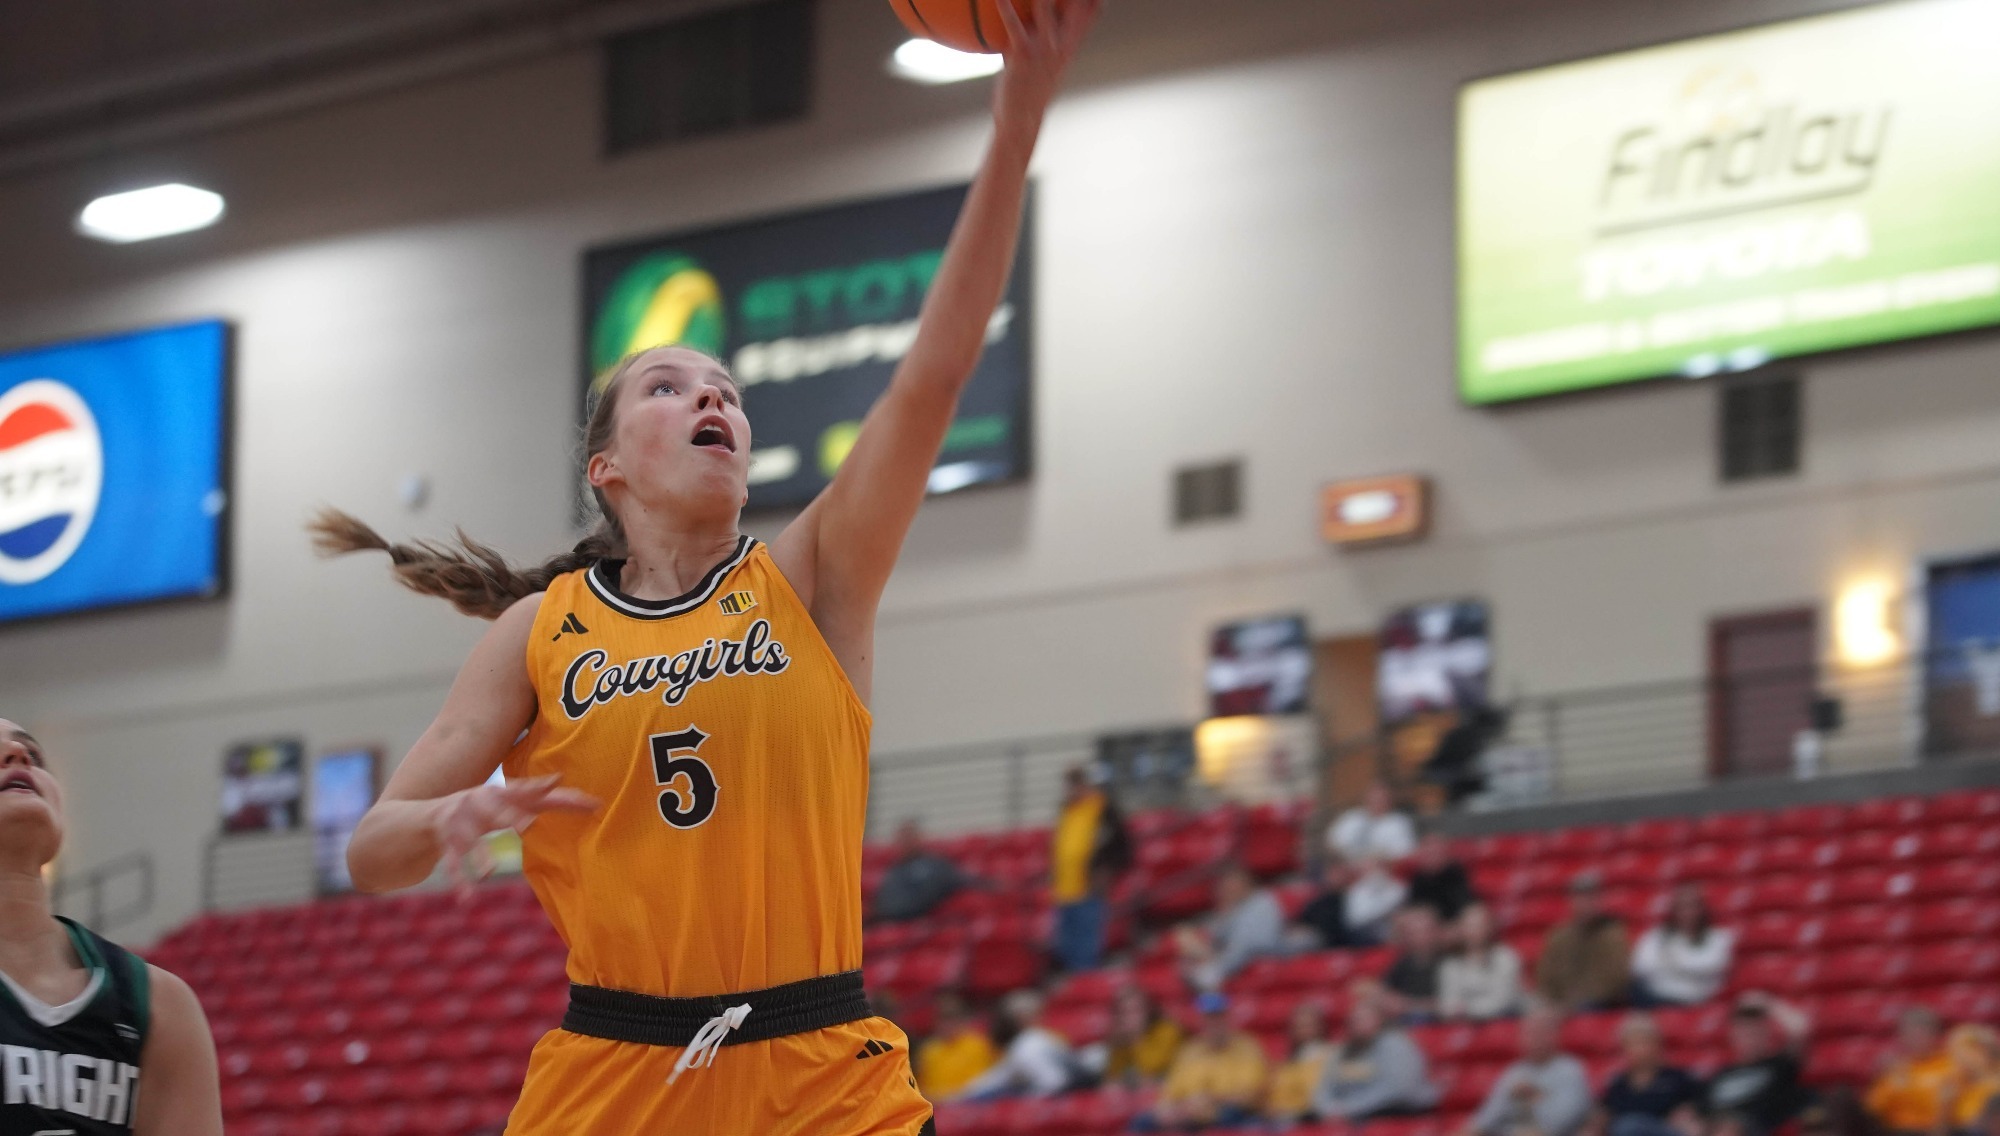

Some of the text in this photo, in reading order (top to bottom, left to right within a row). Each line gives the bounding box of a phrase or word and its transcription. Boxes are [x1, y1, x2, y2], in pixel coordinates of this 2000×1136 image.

[1599, 100, 1893, 207] Findlay
[740, 248, 945, 330] STOT
[1582, 210, 1872, 302] TOYOTA
[558, 618, 791, 721] Cowgirls
[648, 723, 721, 830] 5
[0, 1043, 141, 1129] RIGHT
